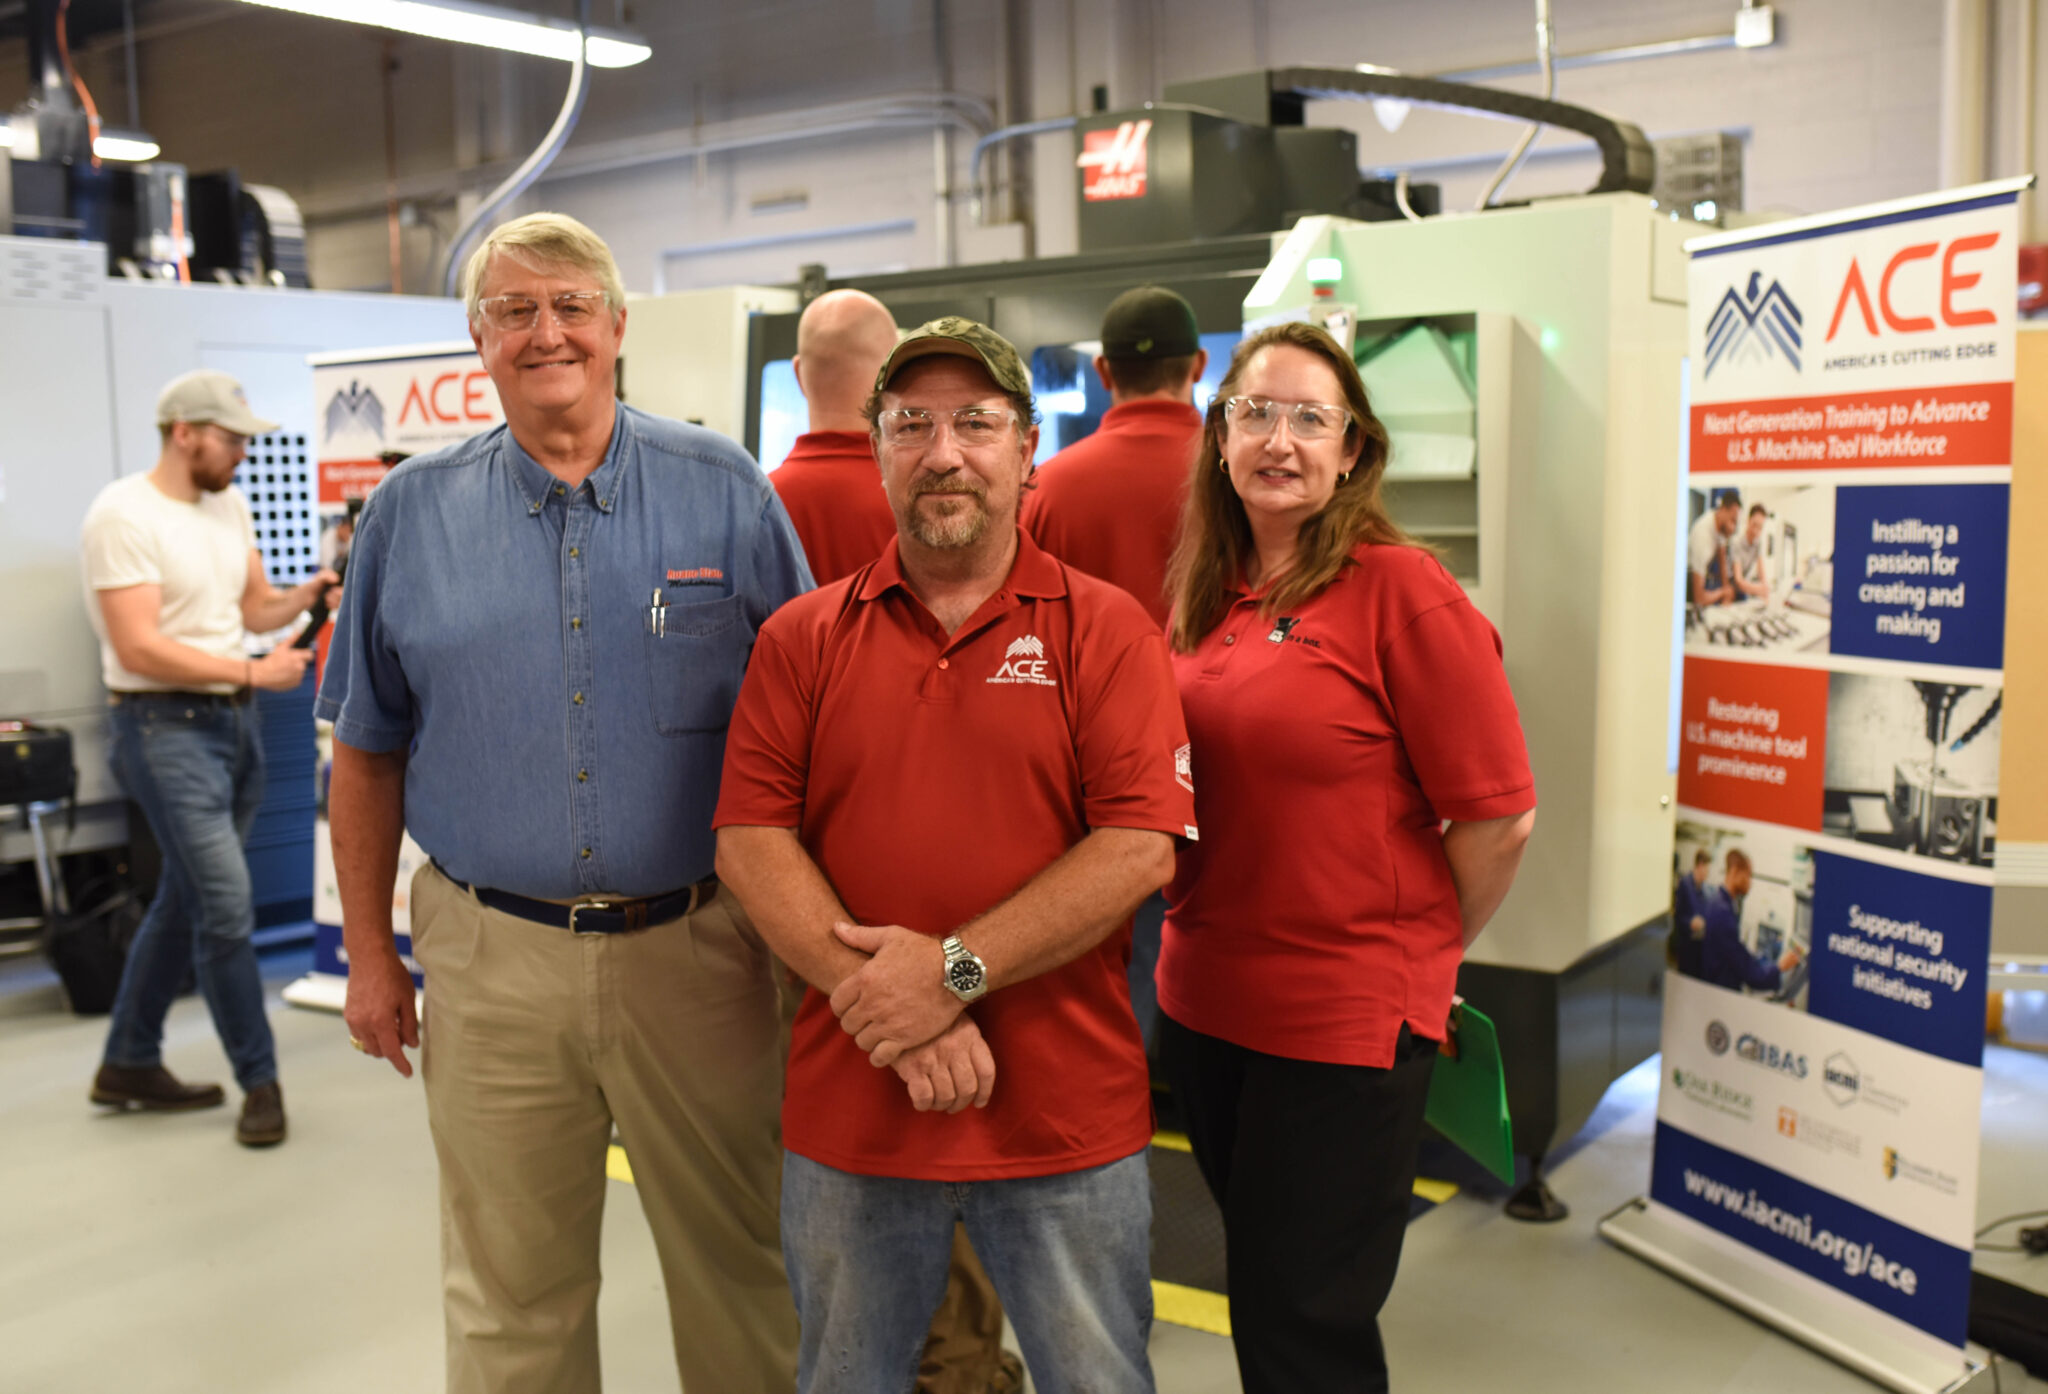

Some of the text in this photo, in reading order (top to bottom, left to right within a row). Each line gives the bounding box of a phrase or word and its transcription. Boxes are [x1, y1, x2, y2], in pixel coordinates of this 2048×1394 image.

[1825, 232, 2000, 343] ACE
[1824, 341, 1998, 371] AMERICA'S CUTTING EDGE
[398, 370, 493, 425] ACE
[1702, 397, 1991, 435] Next Generation Training to Advance
[1727, 430, 1948, 462] U.S. Machine Tool Workforce
[1871, 518, 1959, 550] Instilling a
[1866, 550, 1960, 578] passion for
[1858, 579, 1965, 611] creating and
[1876, 610, 1942, 643] making
[995, 660, 1048, 679] ACE
[1707, 696, 1780, 733] Restoring
[1708, 728, 1773, 755] machine
[1774, 735, 1807, 760] tool
[1697, 754, 1787, 786] prominence
[1849, 904, 1943, 956] Supporting
[1828, 933, 1968, 992] national security
[1852, 964, 1933, 1010] initiatives
[1684, 1168, 1918, 1295] www.iacmi.org/ace
